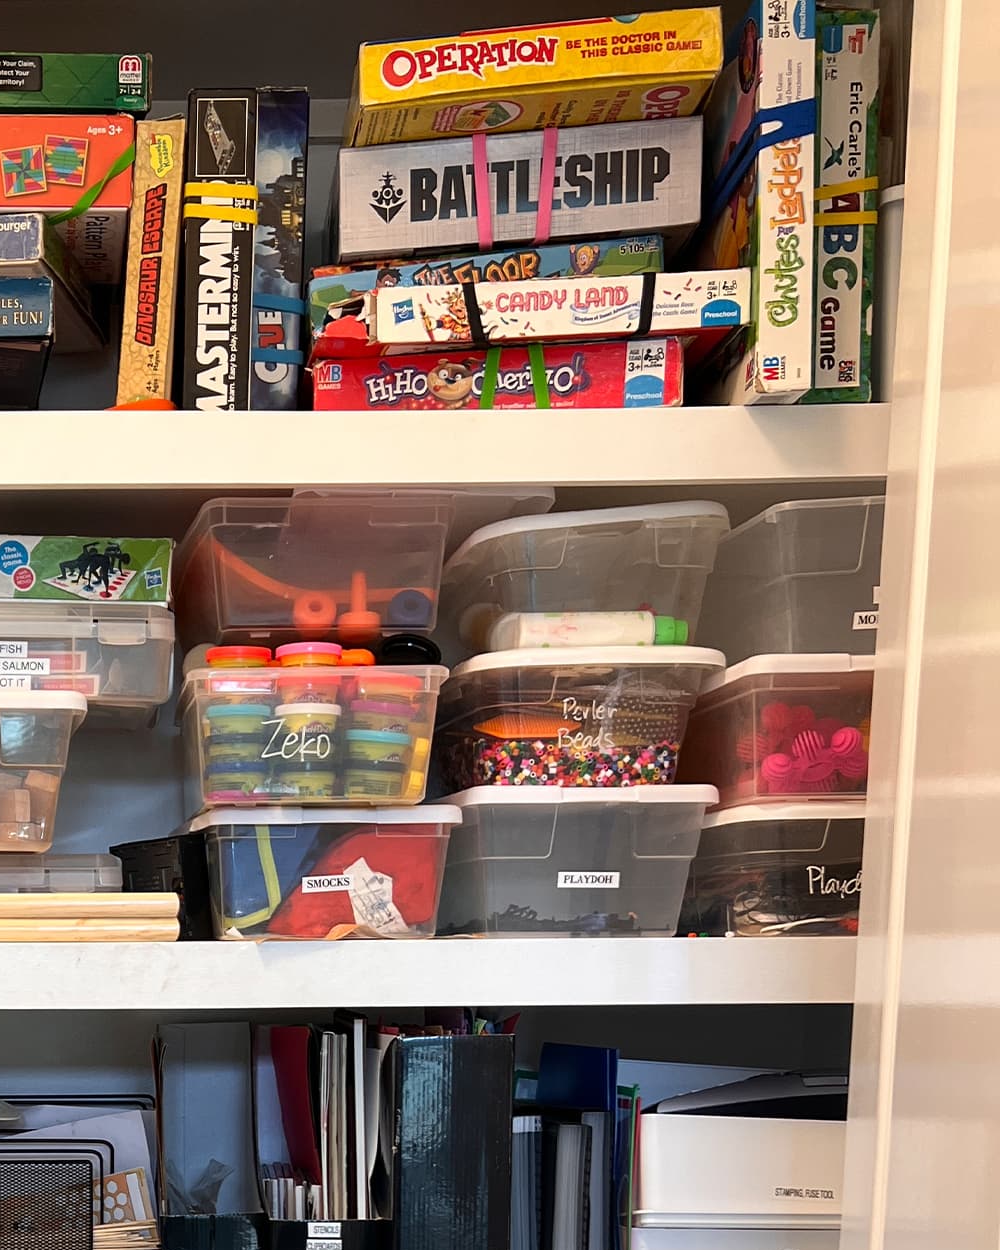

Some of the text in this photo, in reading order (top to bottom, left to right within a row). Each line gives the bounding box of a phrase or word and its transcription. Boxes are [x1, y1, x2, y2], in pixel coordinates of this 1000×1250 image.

[781, 25, 790, 38] 3+
[565, 30, 677, 50] BE THE DOCTOR IN
[580, 39, 702, 58] THIS CLASSIC GAME!
[16, 60, 36, 68] Claim,
[381, 37, 558, 90] OPERATION
[15, 69, 29, 77] Your
[108, 124, 123, 135] 3+
[848, 81, 864, 178] Eric Carle's
[409, 146, 671, 223] BATTLESHIP
[142, 183, 167, 256] ESCAPE
[232, 263, 239, 273] to
[452, 250, 541, 284] FLOOR
[232, 274, 240, 291] easy
[764, 233, 804, 328] Chutes
[134, 256, 161, 347] DINOSAUR
[232, 293, 238, 303] so
[495, 285, 629, 313] CANDY LAND
[706, 291, 717, 300] 3+
[13, 311, 43, 325] FUN!
[704, 310, 738, 318] Preschool
[230, 318, 238, 332] But
[819, 296, 841, 371] Game
[229, 334, 239, 352] play.
[254, 311, 289, 385] CUE
[229, 362, 239, 380] Easy
[317, 364, 342, 382] MB
[628, 362, 641, 372] 3+
[763, 356, 779, 380] MB
[317, 383, 341, 391] GAMES
[626, 391, 663, 400] Preschool
[857, 614, 879, 625] MO
[0, 643, 23, 654] FISH
[2, 661, 44, 671] SALMON
[16, 677, 26, 688] IT
[557, 726, 616, 749] Beads
[306, 876, 351, 889] SMOCKS
[563, 874, 614, 884] PLAYDOH
[820, 1190, 834, 1199] TOOL
